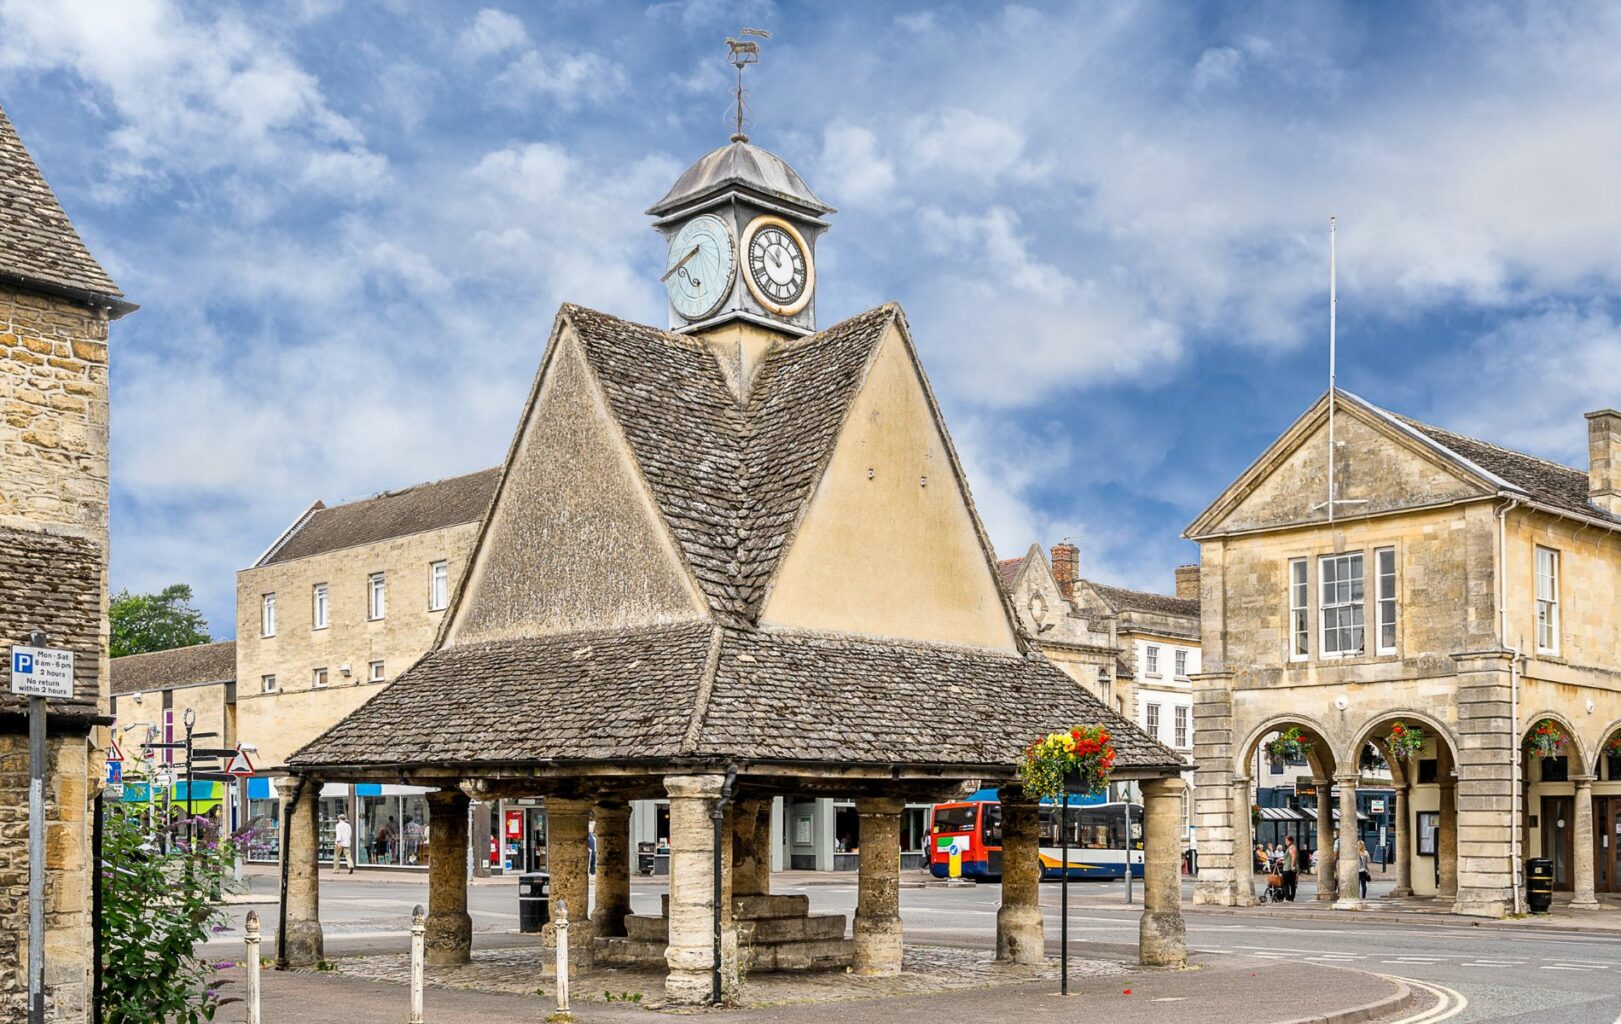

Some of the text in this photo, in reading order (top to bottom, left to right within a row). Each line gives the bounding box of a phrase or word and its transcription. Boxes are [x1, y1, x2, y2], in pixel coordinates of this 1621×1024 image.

[18, 655, 31, 672] P
[46, 670, 66, 678] hours
[47, 687, 67, 695] hours
